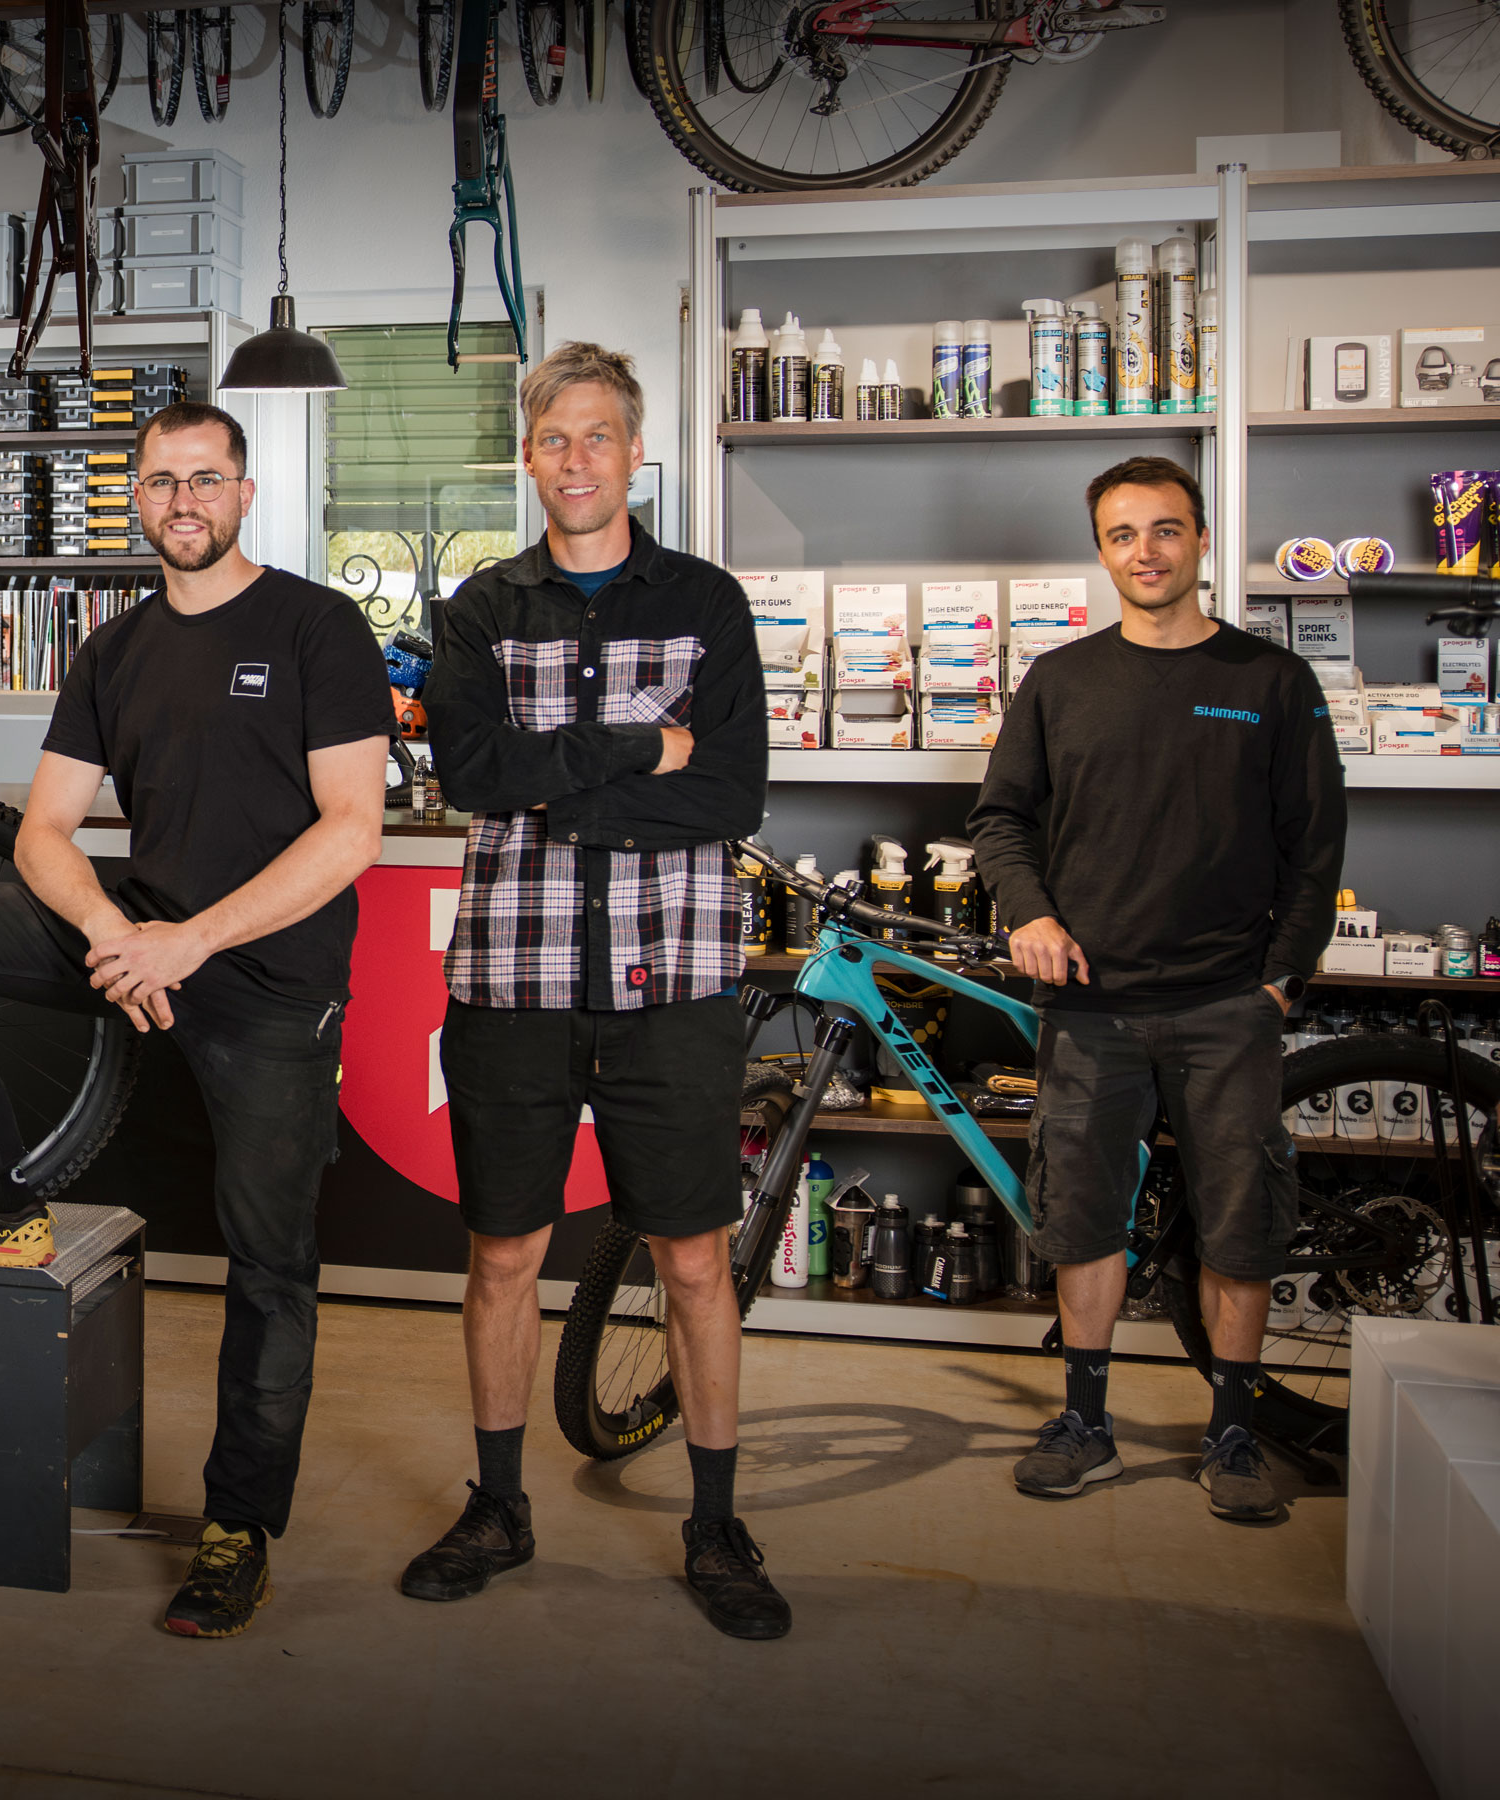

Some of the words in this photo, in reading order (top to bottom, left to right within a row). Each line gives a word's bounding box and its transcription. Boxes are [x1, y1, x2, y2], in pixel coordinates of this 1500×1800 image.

[656, 55, 697, 134] MAXXIS
[1379, 336, 1389, 399] GARMIN
[1449, 480, 1483, 513] Chamois
[1298, 624, 1331, 633] SPORT
[1298, 633, 1337, 642] DRINKS
[1193, 705, 1260, 724] SHIMANO
[743, 892, 753, 933] CLEAN
[877, 1010, 965, 1116] YETI
[931, 1256, 947, 1289] CAMELBAK
[617, 1413, 665, 1446] MAXXIS
